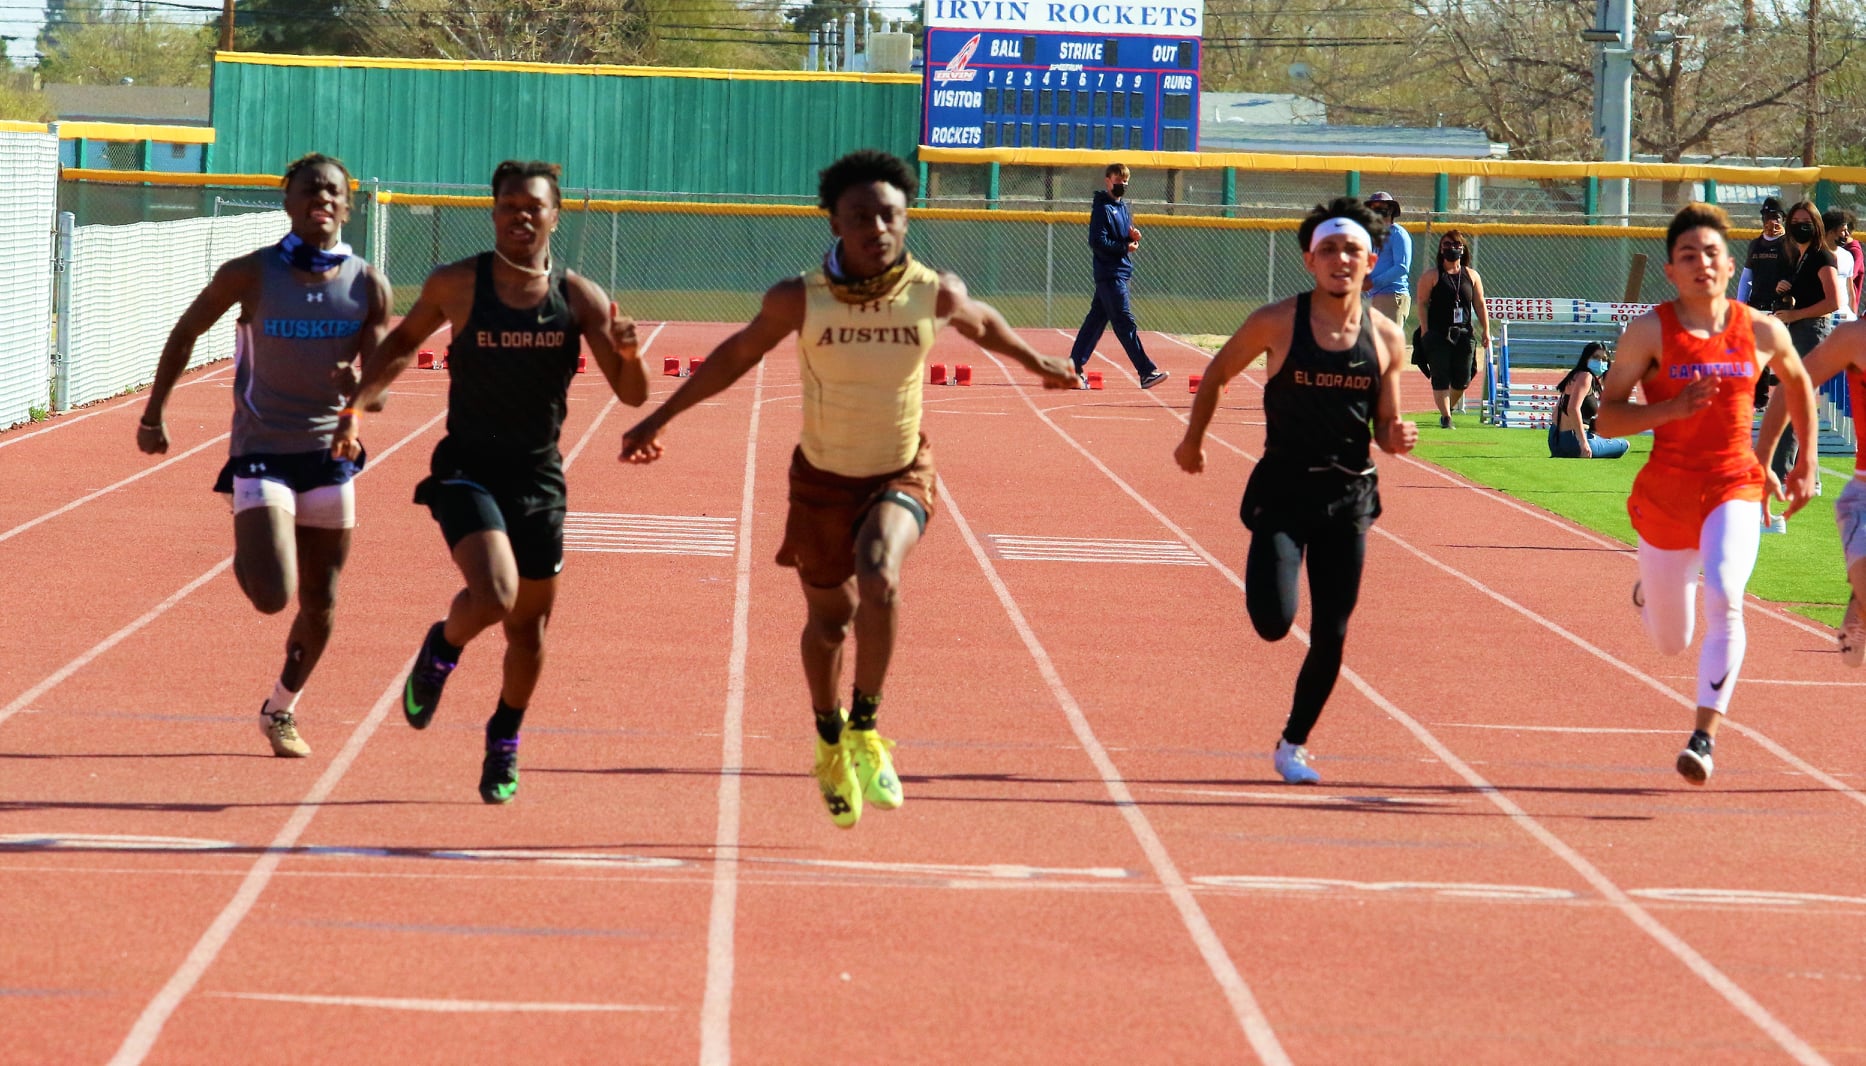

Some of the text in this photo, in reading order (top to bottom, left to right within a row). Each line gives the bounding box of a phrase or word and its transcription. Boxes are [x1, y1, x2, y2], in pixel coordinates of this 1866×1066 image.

[934, 0, 1197, 27] IRVIN ROCKETS
[990, 39, 1021, 58] BALL
[1059, 41, 1103, 60] STRIKE
[1152, 44, 1178, 63] OUT
[988, 70, 1142, 88] 1 2 3 4 5 6 7 8 9
[1163, 75, 1193, 90] RUNS
[933, 89, 982, 108] VISITOR
[931, 126, 981, 144] ROCKETS
[1488, 312, 1553, 320] ROCKETS
[477, 331, 565, 348] EL DORADO
[816, 325, 920, 346] AUSTIN
[1294, 370, 1371, 389] EL DORADO
